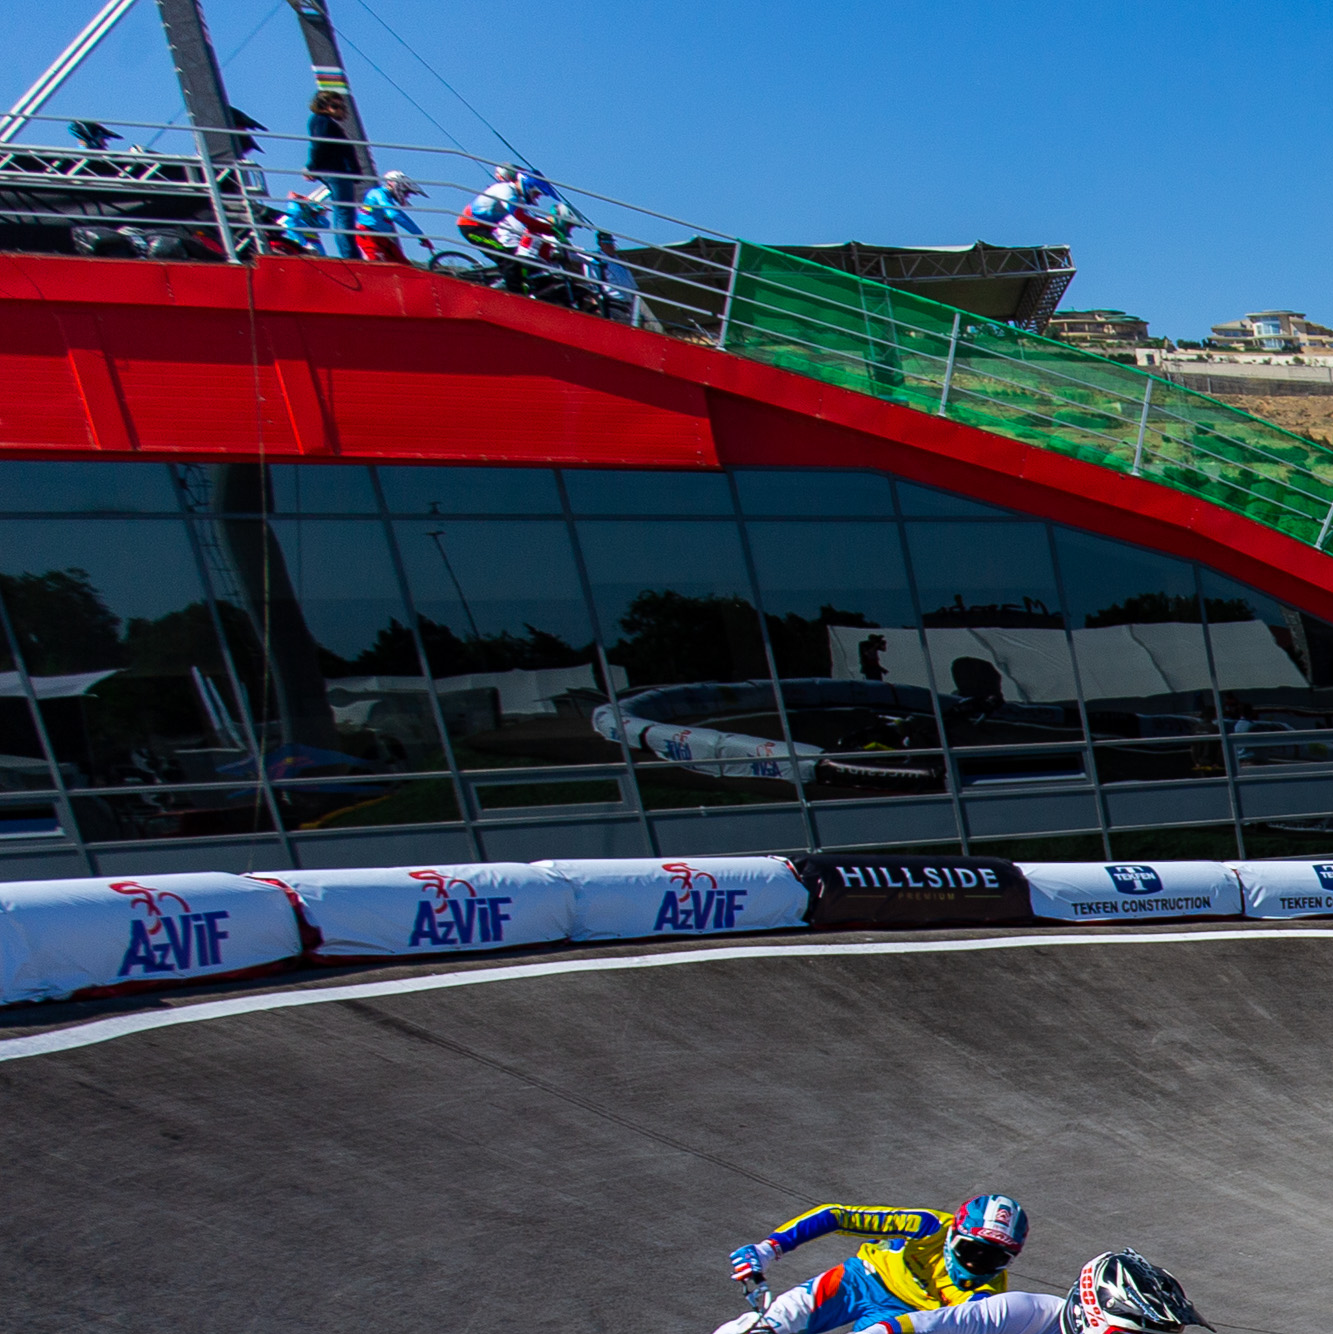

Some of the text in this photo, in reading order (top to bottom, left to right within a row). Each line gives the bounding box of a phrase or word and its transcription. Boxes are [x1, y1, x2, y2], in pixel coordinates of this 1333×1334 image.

[836, 866, 1000, 888] HILLSIDE
[1113, 872, 1156, 881] TEKFEN
[898, 892, 956, 900] PREMIUM
[1280, 897, 1323, 910] TEKFEN
[1072, 897, 1211, 915] TEKFEN CONSTRUCTION
[1080, 1265, 1108, 1327] 100%
